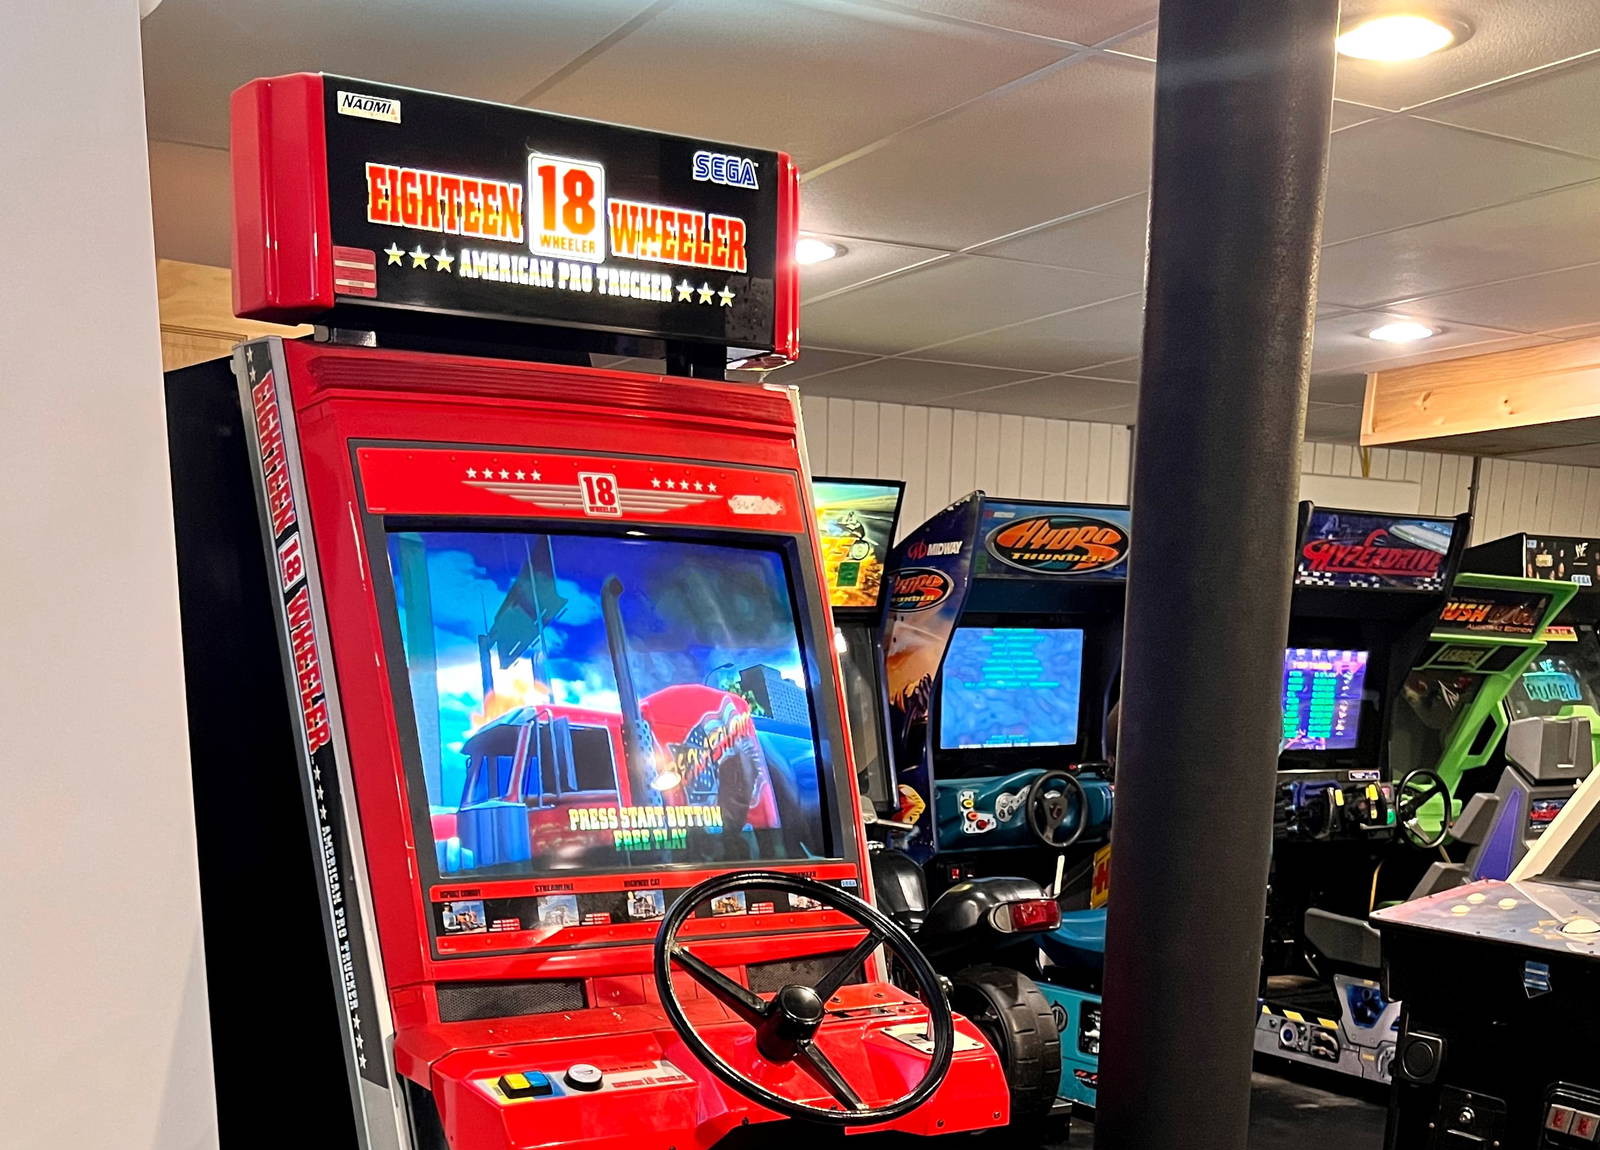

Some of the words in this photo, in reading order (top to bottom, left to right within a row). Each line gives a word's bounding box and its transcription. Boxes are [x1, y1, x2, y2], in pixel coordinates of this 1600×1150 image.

[342, 94, 392, 114] NAOMI
[692, 151, 759, 190] SEGA
[366, 163, 523, 242] EIGHTEEN
[537, 164, 597, 236] 18
[608, 199, 747, 272] WHEELER
[540, 234, 596, 254] WHEELER
[459, 248, 554, 288] AMERICAN
[557, 261, 594, 293] PRO
[595, 266, 673, 302] TRUCKER
[252, 369, 297, 539] EIGHTEEN
[583, 476, 616, 506] 18
[283, 539, 302, 583] 18
[926, 541, 963, 556] MIDWAY
[996, 519, 1122, 570] HYDRO
[1011, 552, 1105, 563] THUNDER
[1302, 529, 1444, 578] HYPERDRIVE
[286, 585, 331, 755] WHEELER
[568, 808, 618, 831] PRESS
[620, 806, 665, 829] START
[666, 806, 723, 827] BUTTON
[613, 829, 650, 851] FREE
[653, 829, 688, 849] PLAY
[322, 826, 343, 905] AMERICAN
[334, 907, 348, 939] PRO
[340, 941, 360, 1010] TRUCKER
